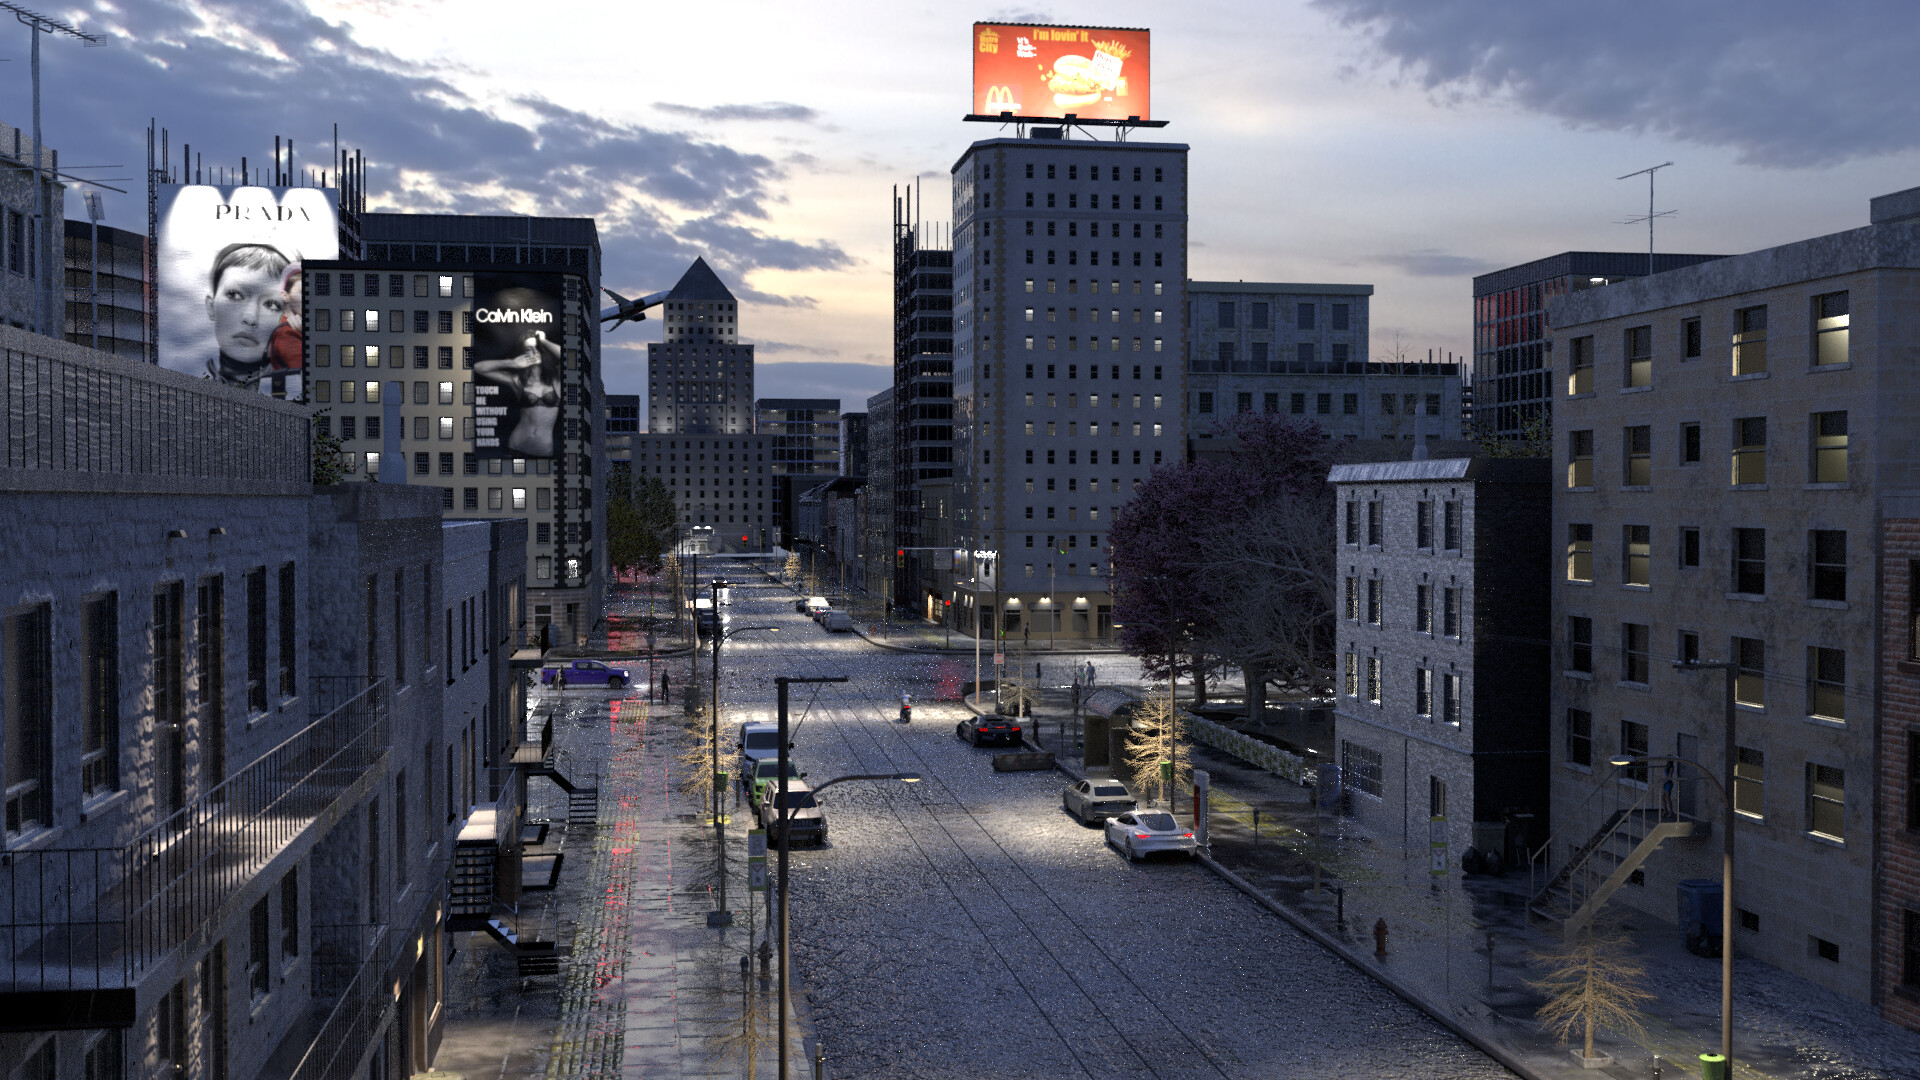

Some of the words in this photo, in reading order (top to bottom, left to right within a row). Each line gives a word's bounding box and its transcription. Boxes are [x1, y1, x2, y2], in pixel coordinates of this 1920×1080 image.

[979, 42, 998, 53] City
[476, 308, 519, 323] Calvin
[520, 308, 553, 323] Klein
[475, 385, 499, 395] TOUCH
[475, 396, 487, 405] ME
[475, 406, 508, 416] WITHOUT
[476, 417, 498, 426] USING
[476, 427, 495, 437] YOUR
[476, 437, 500, 447] HANDS
